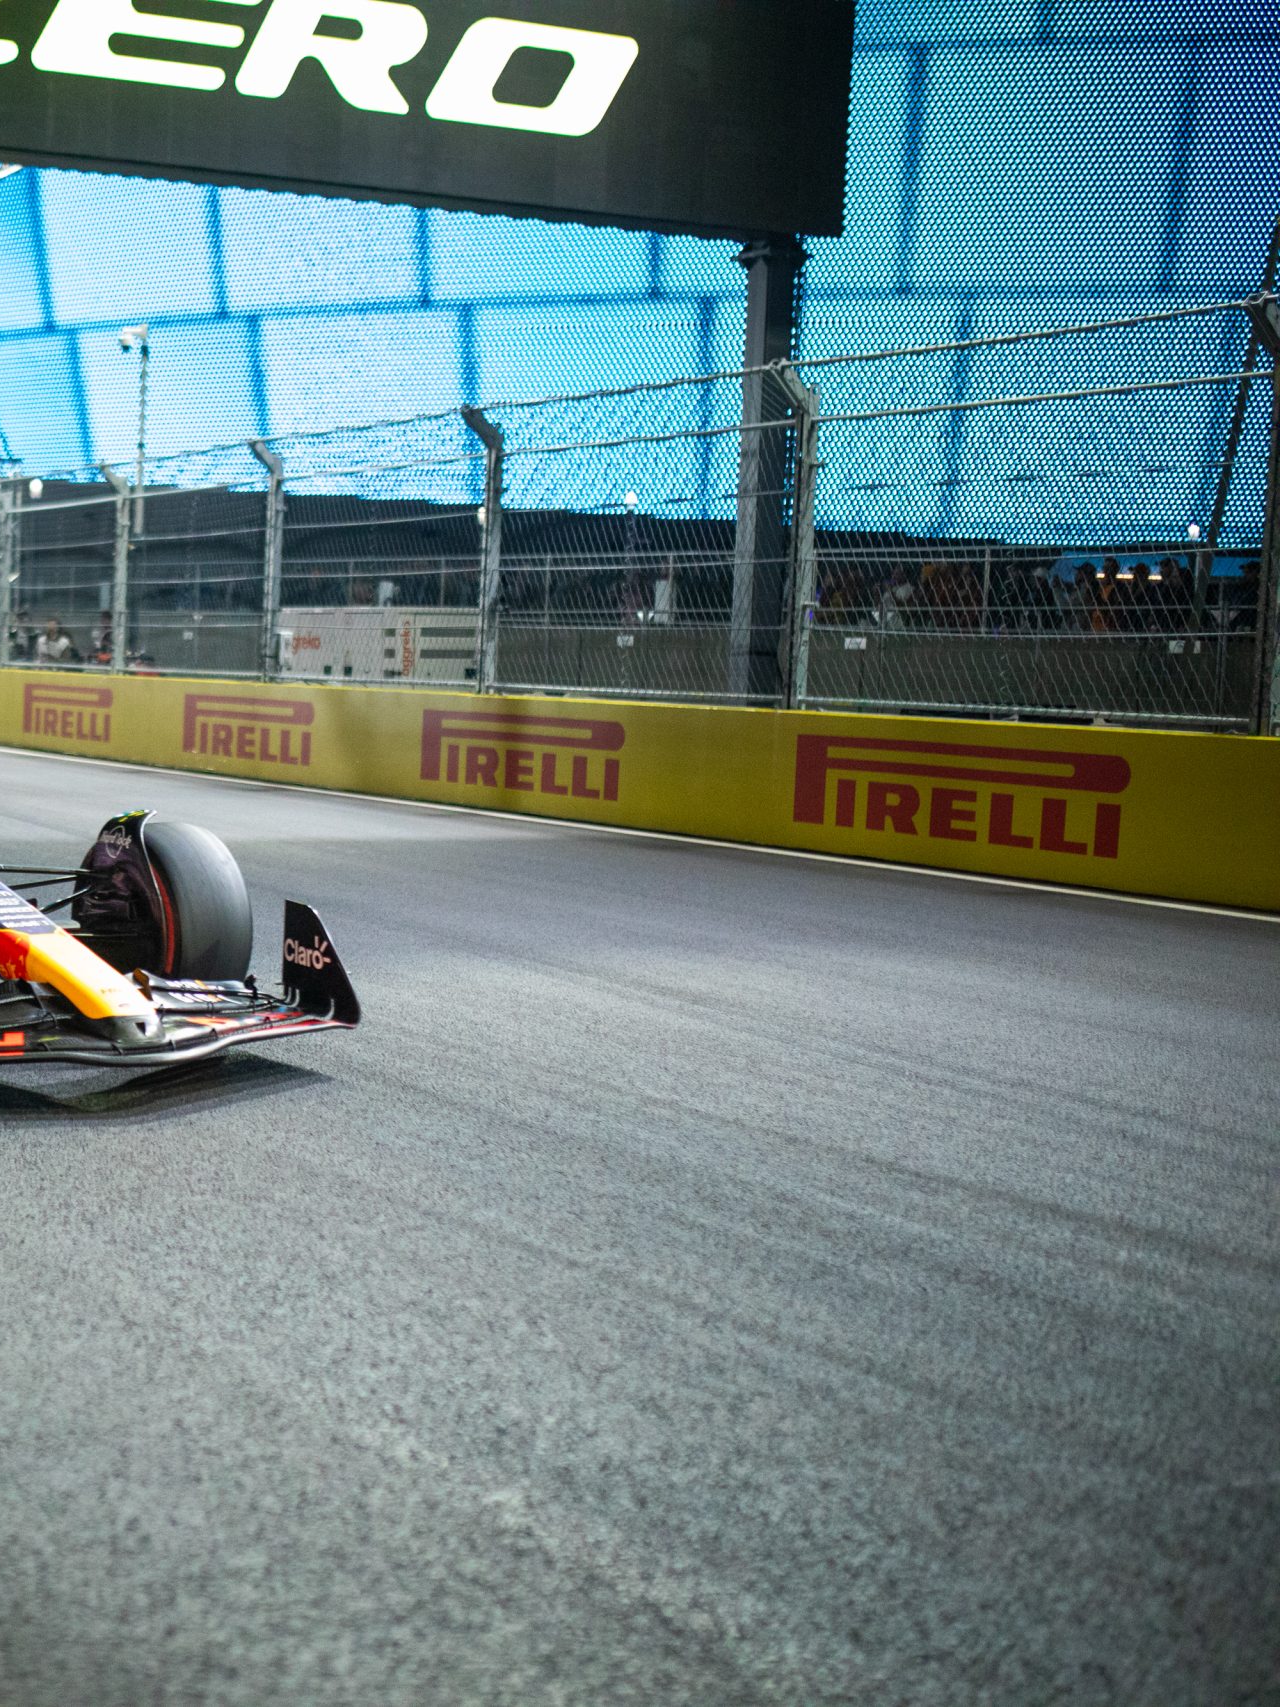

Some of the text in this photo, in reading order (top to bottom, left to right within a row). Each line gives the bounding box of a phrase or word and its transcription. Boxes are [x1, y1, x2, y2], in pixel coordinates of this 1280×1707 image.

[23, 683, 113, 742] PIRELLI
[183, 694, 315, 766] PIRELLI
[421, 709, 626, 801] PIRELLI
[793, 734, 1132, 859] PIRELLI
[284, 938, 325, 970] Claro
